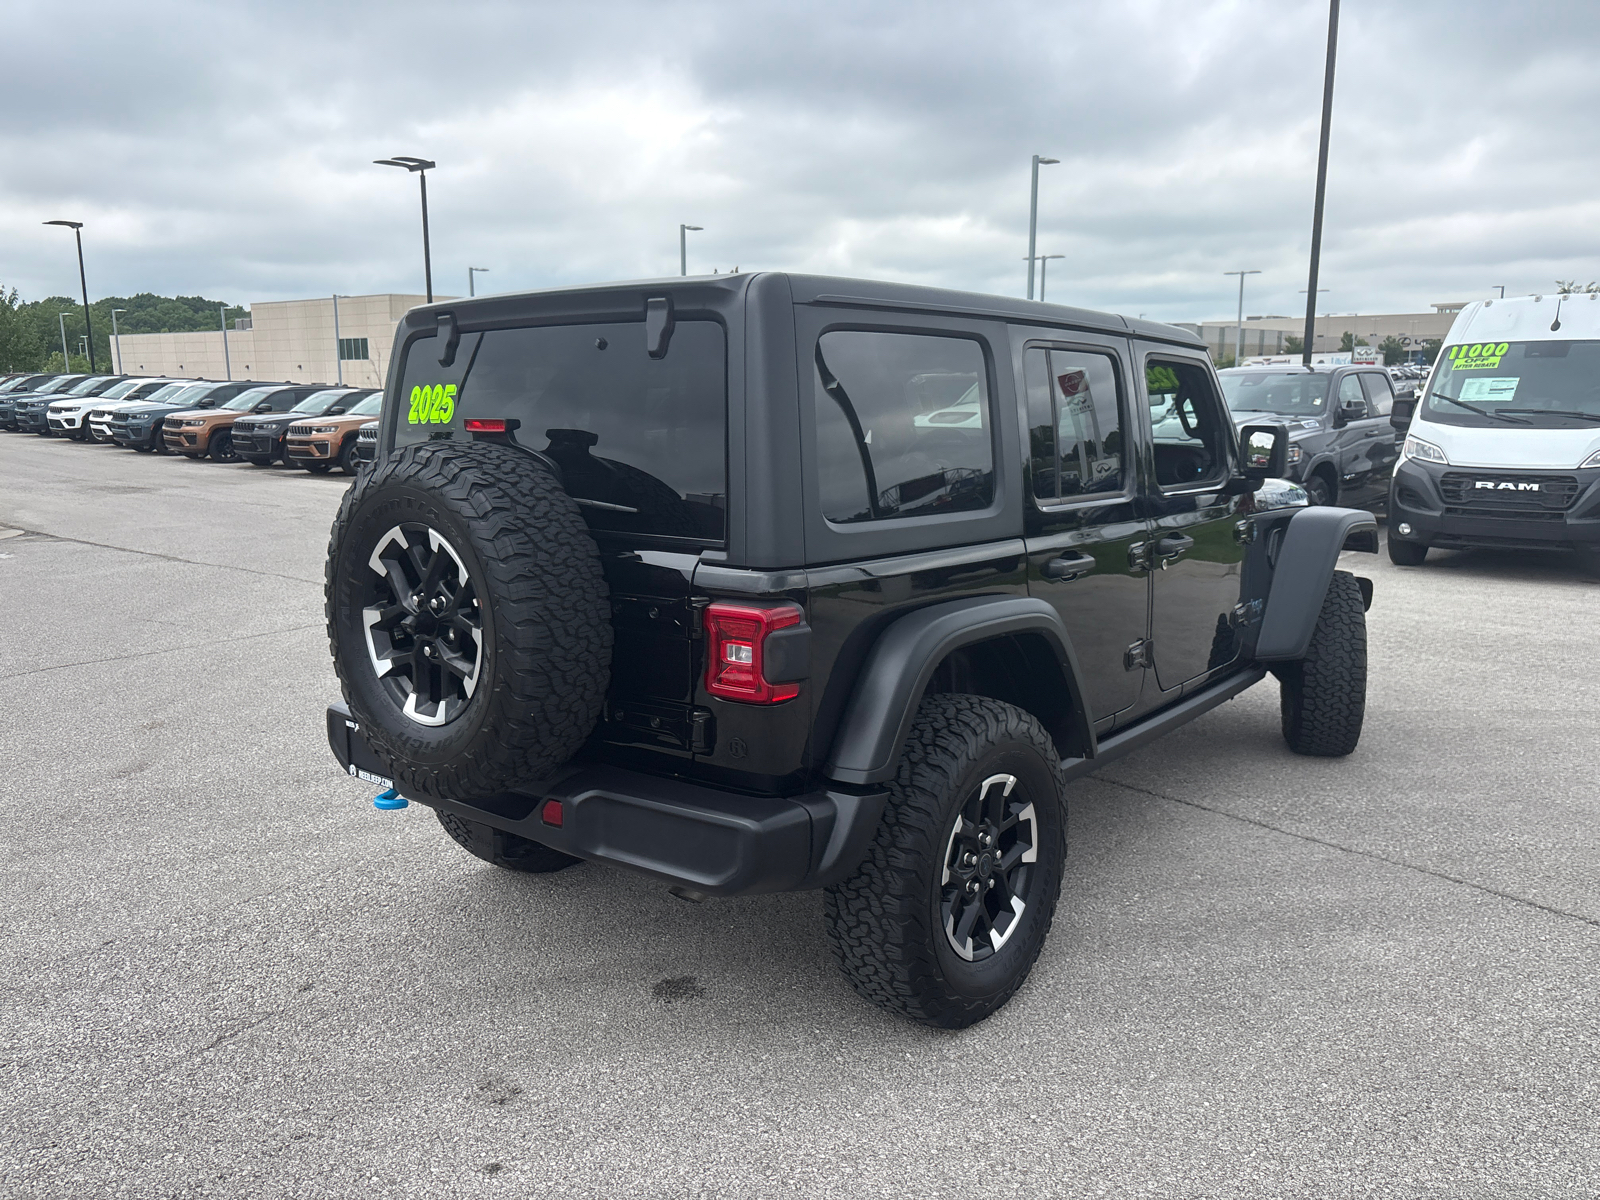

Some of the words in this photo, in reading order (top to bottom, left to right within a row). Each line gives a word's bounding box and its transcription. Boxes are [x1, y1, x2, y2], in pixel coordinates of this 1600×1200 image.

[1449, 343, 1509, 359] 11000
[408, 384, 457, 424] 2025
[1475, 482, 1539, 491] RAM
